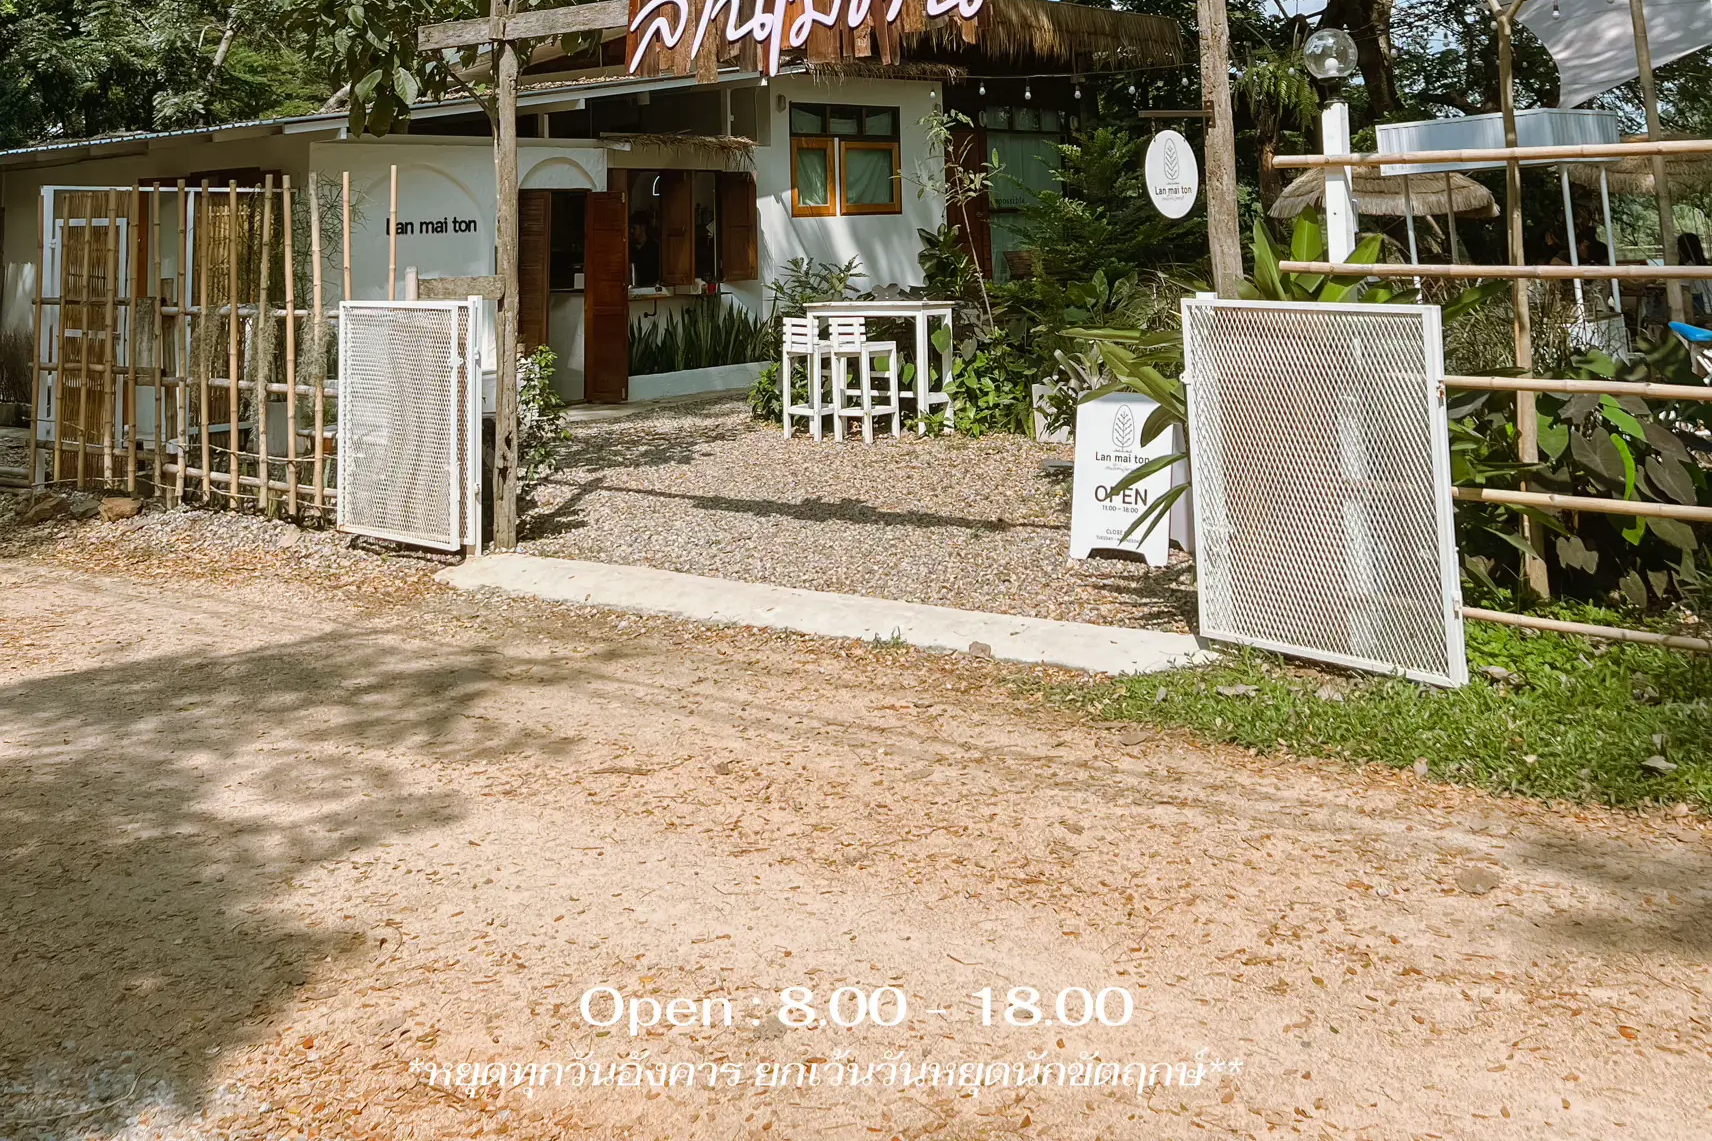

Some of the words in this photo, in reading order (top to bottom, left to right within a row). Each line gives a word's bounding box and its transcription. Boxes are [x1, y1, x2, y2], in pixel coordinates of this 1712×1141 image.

[1154, 186, 1166, 196] Lan
[1168, 186, 1180, 195] mai
[1181, 186, 1192, 194] ton
[419, 217, 448, 234] mai
[452, 217, 477, 233] ton
[1095, 451, 1111, 462] Lan
[1114, 453, 1131, 464] mai
